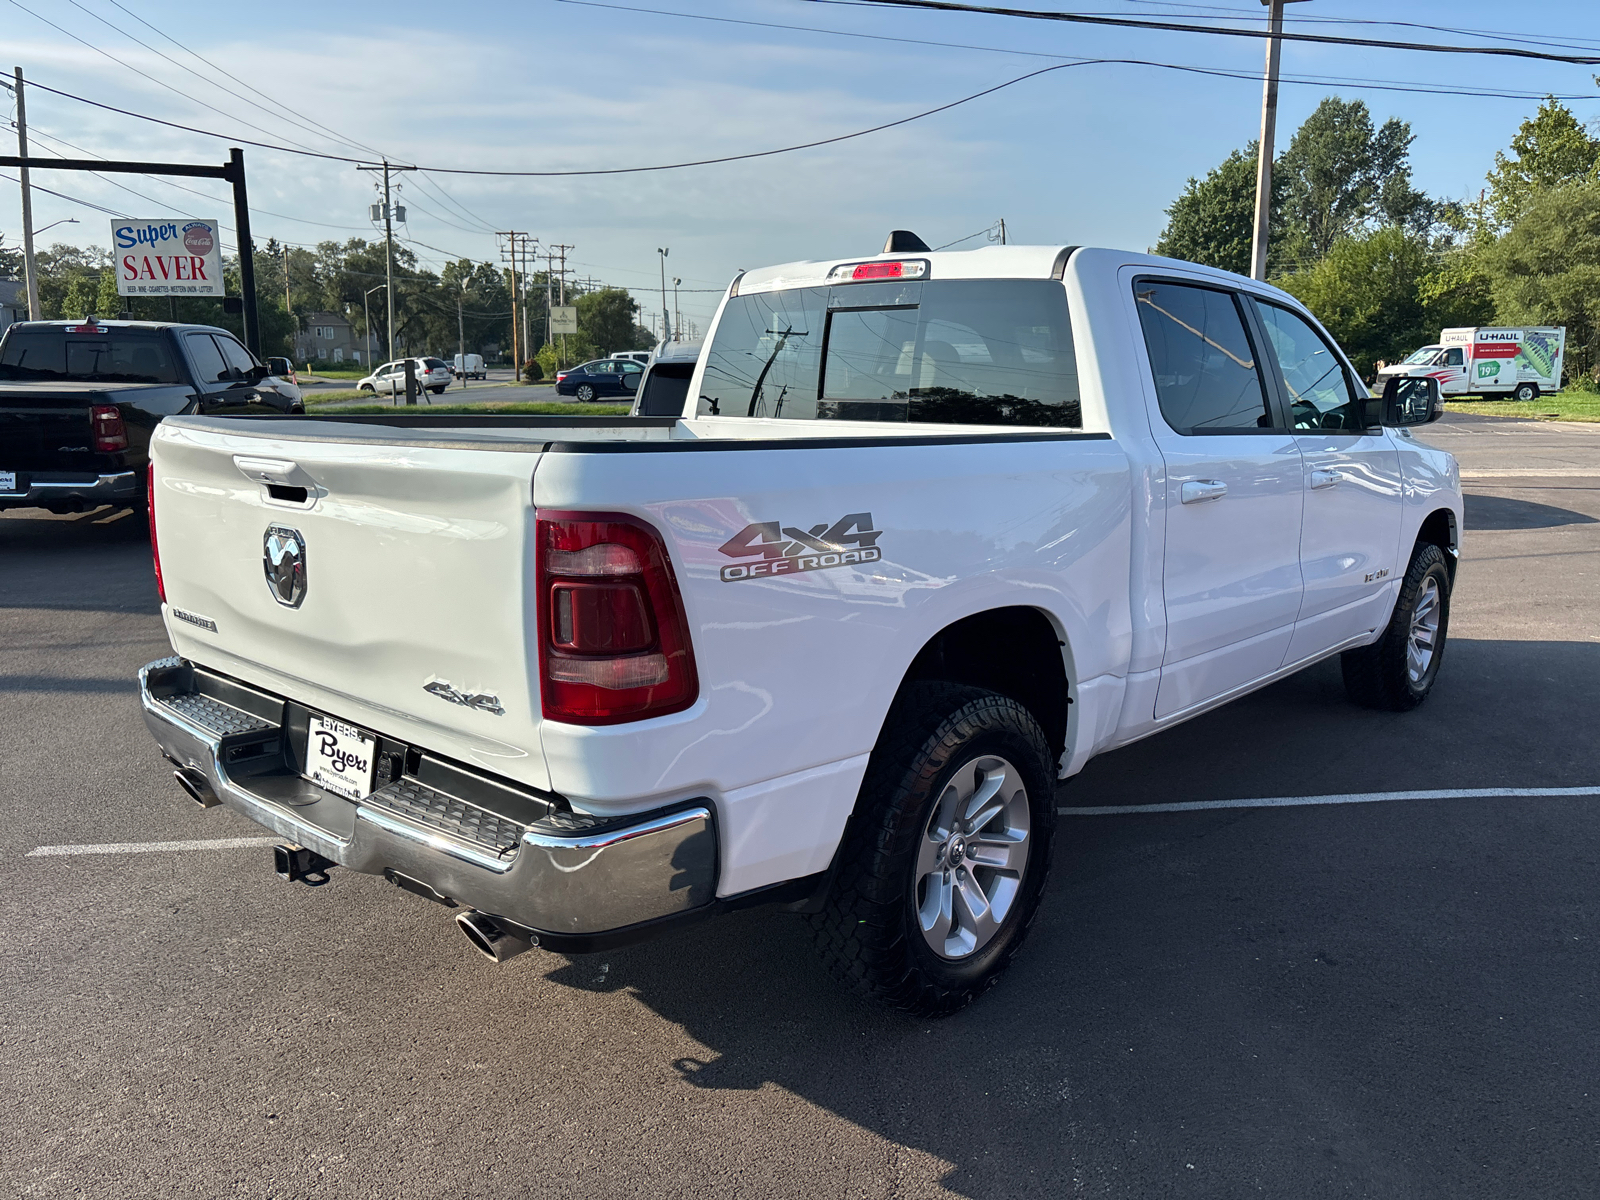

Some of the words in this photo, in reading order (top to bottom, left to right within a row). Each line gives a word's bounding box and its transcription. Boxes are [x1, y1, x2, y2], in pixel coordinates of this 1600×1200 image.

[116, 223, 178, 248] Super
[123, 255, 209, 281] SAVER
[1479, 333, 1519, 341] U-HAUL
[724, 560, 791, 579] OFF
[798, 549, 879, 570] ROAD
[323, 717, 359, 740] BYERS
[315, 731, 367, 773] Byers
